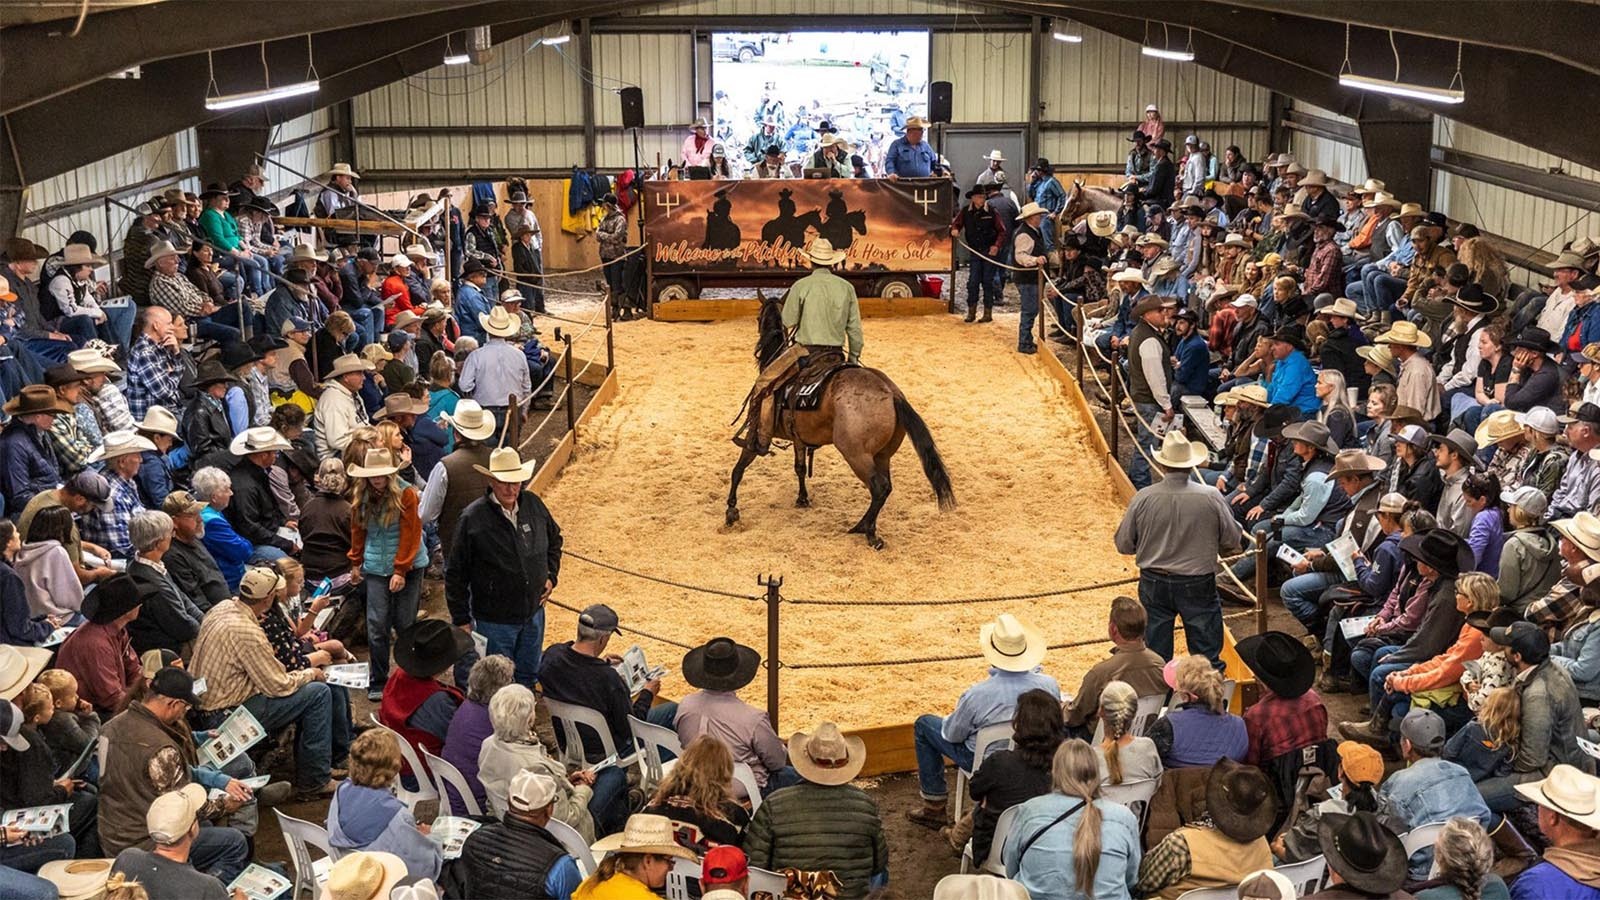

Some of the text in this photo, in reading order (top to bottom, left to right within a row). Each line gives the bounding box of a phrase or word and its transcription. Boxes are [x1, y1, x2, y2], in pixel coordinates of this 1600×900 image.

[655, 240, 721, 264] Welcome
[862, 243, 898, 259] Horse
[902, 240, 934, 260] Sale
